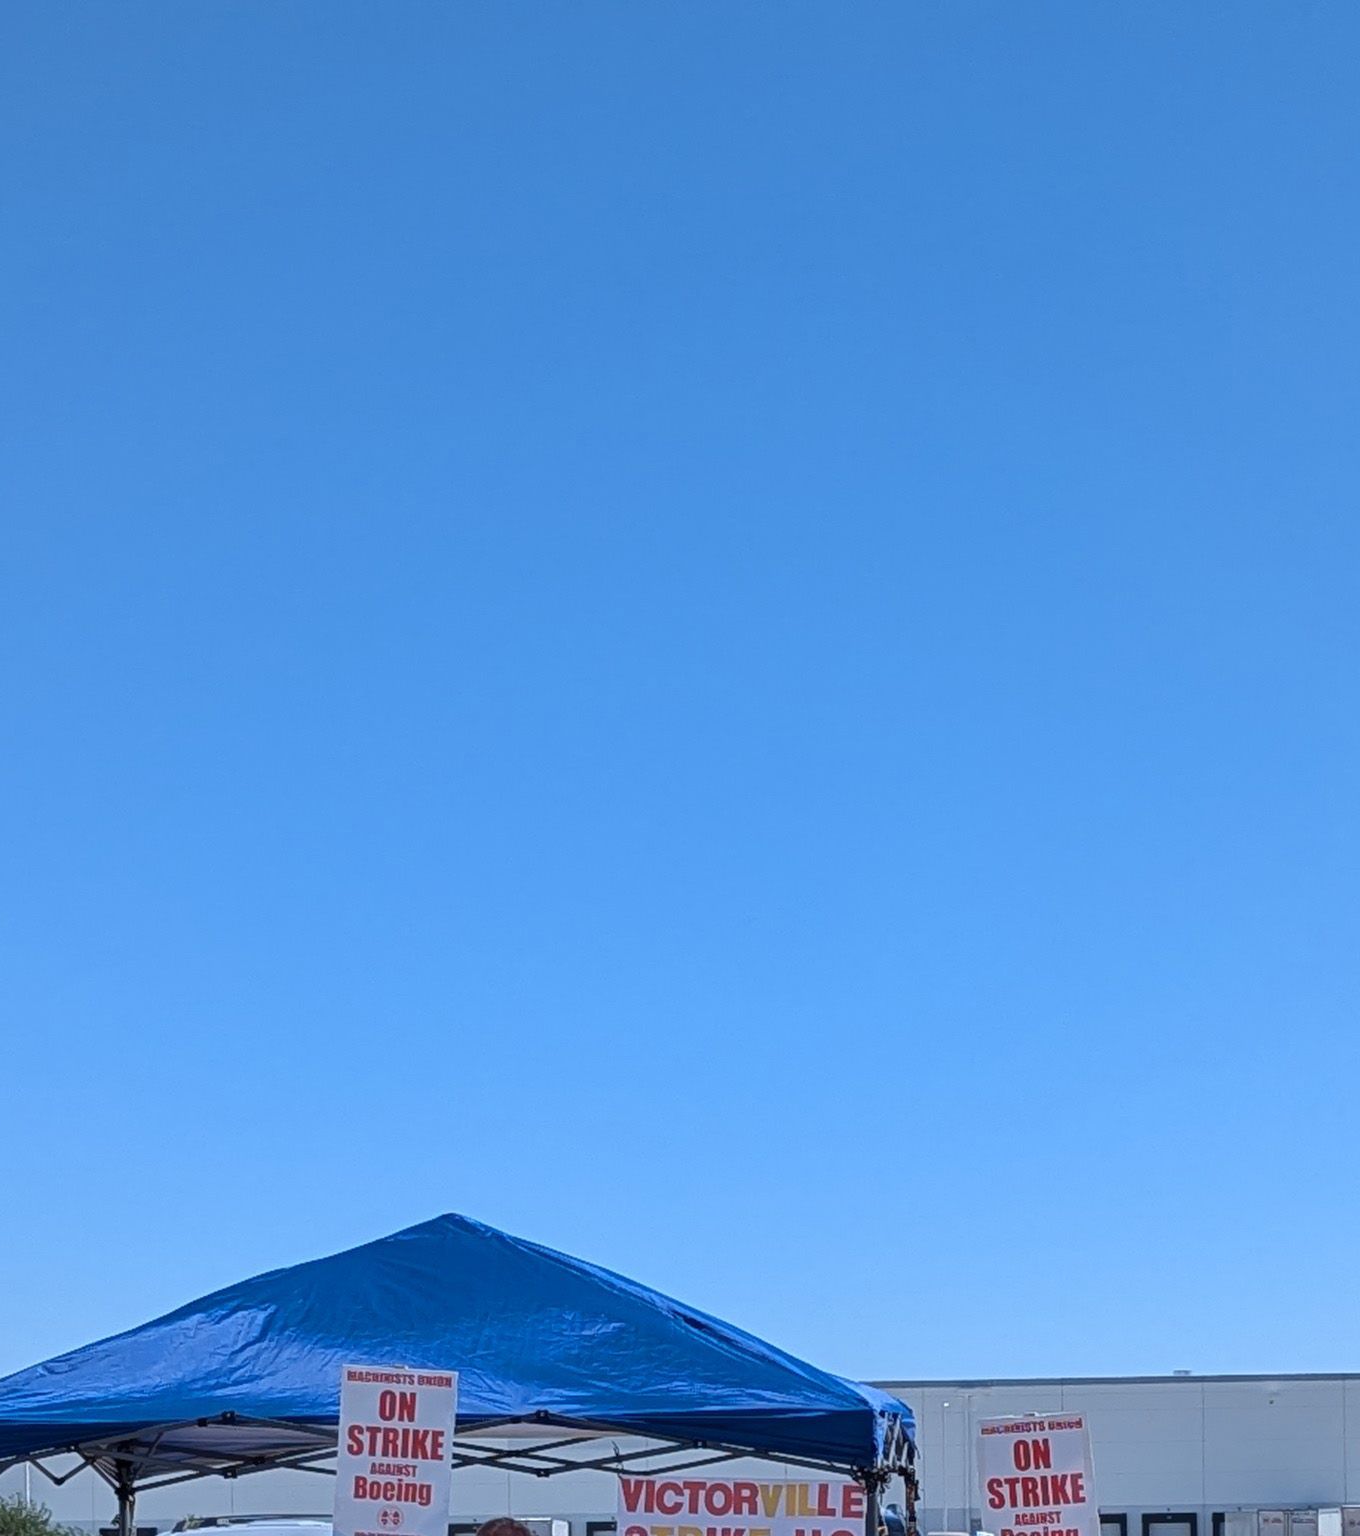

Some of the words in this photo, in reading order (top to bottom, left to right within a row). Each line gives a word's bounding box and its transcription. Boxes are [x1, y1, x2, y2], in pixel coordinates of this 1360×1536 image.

[378, 1389, 416, 1423] ON
[347, 1424, 445, 1461] STRIKE
[1013, 1437, 1051, 1471] ON
[370, 1462, 418, 1477] AGAINST
[353, 1475, 432, 1507] Boeing
[621, 1478, 865, 1518] VICTORVILLE
[987, 1472, 1086, 1510] STRIKE
[1014, 1511, 1062, 1526] AGAINST
